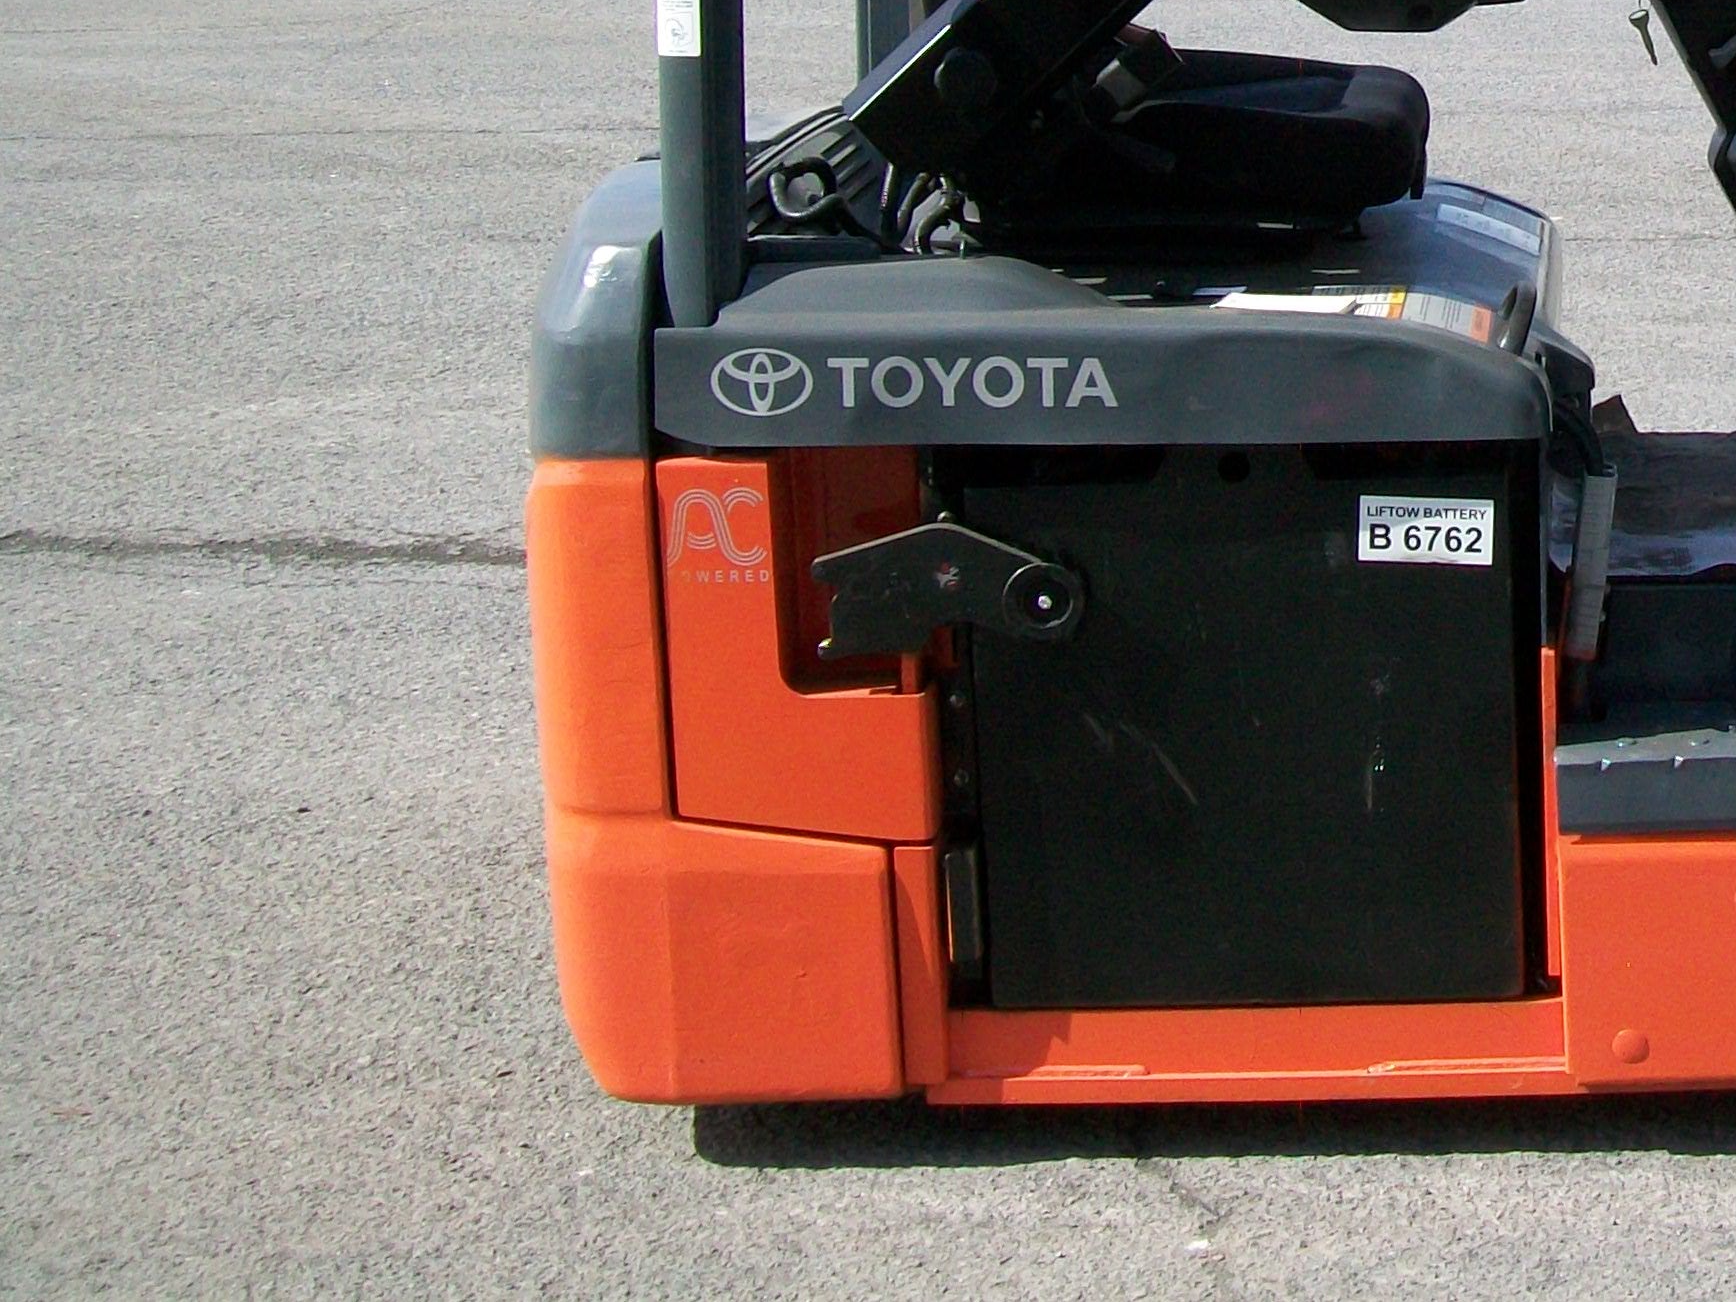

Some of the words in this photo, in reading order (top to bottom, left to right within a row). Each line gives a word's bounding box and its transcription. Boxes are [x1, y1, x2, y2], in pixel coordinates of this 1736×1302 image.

[827, 356, 1119, 408] TOYOTA
[1367, 506, 1420, 518] LIFTOW
[1423, 508, 1487, 520] BATTERY
[1369, 523, 1391, 550] B
[1404, 525, 1483, 553] 6762
